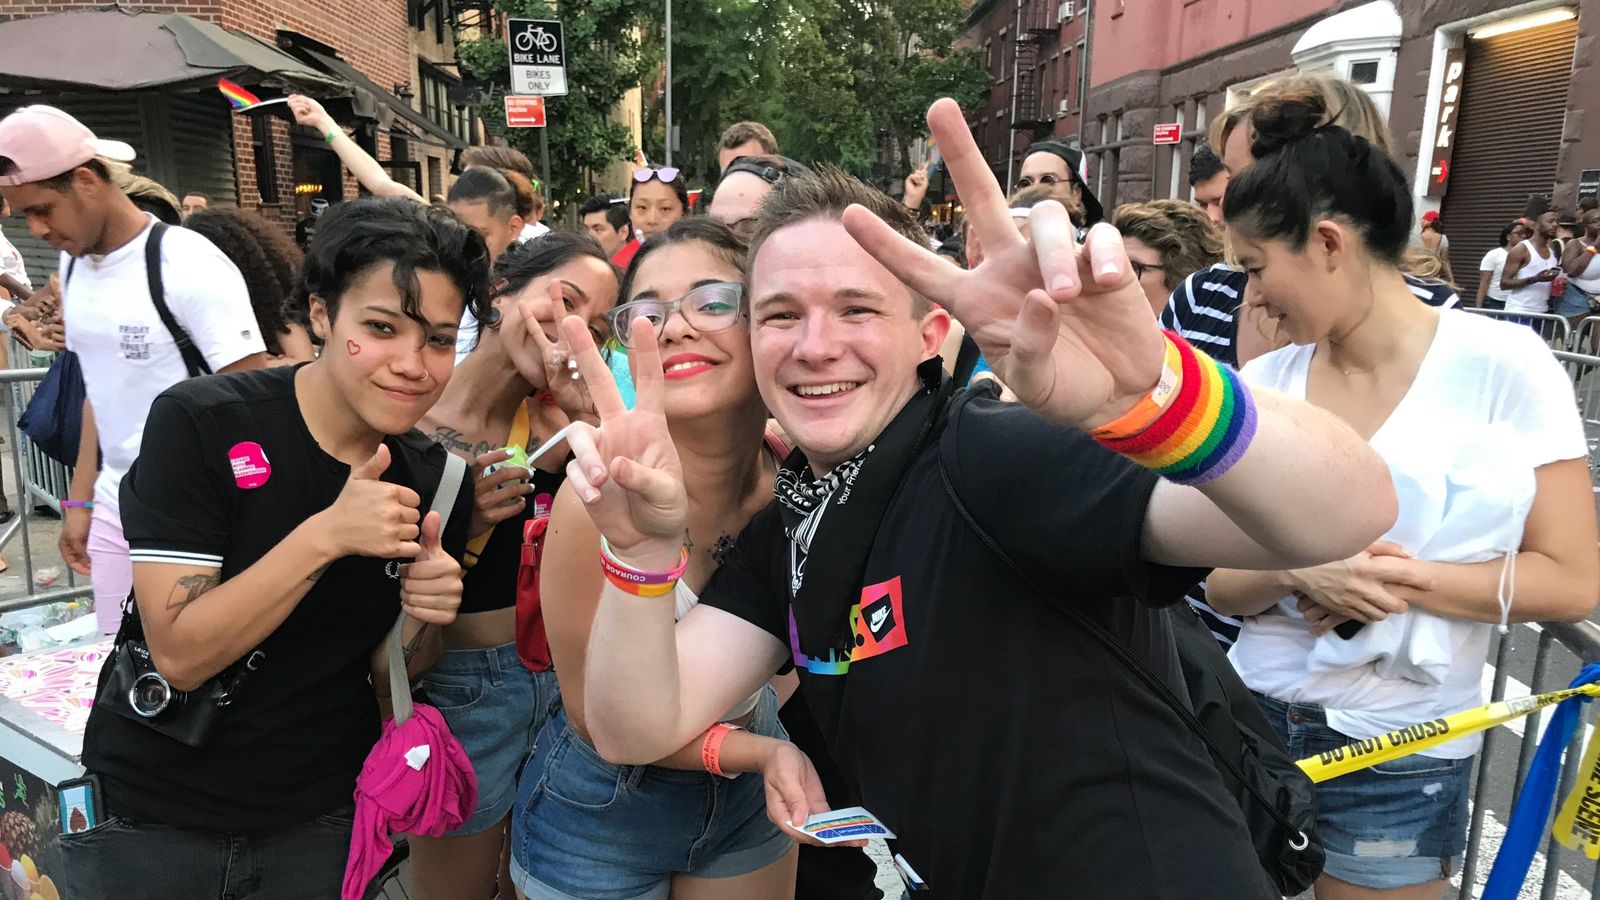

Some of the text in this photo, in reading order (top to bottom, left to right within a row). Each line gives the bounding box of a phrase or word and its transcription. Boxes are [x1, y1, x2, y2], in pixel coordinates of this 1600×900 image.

[513, 53, 561, 64] BIKE LANE
[526, 70, 551, 80] BIKES
[528, 82, 551, 91] ONLY
[1436, 62, 1463, 148] park
[837, 484, 853, 506] Your
[606, 563, 646, 582] COURAGE
[871, 605, 887, 624] NIKE
[134, 646, 150, 656] LEICA
[1318, 717, 1450, 767] DO NOT CROSS
